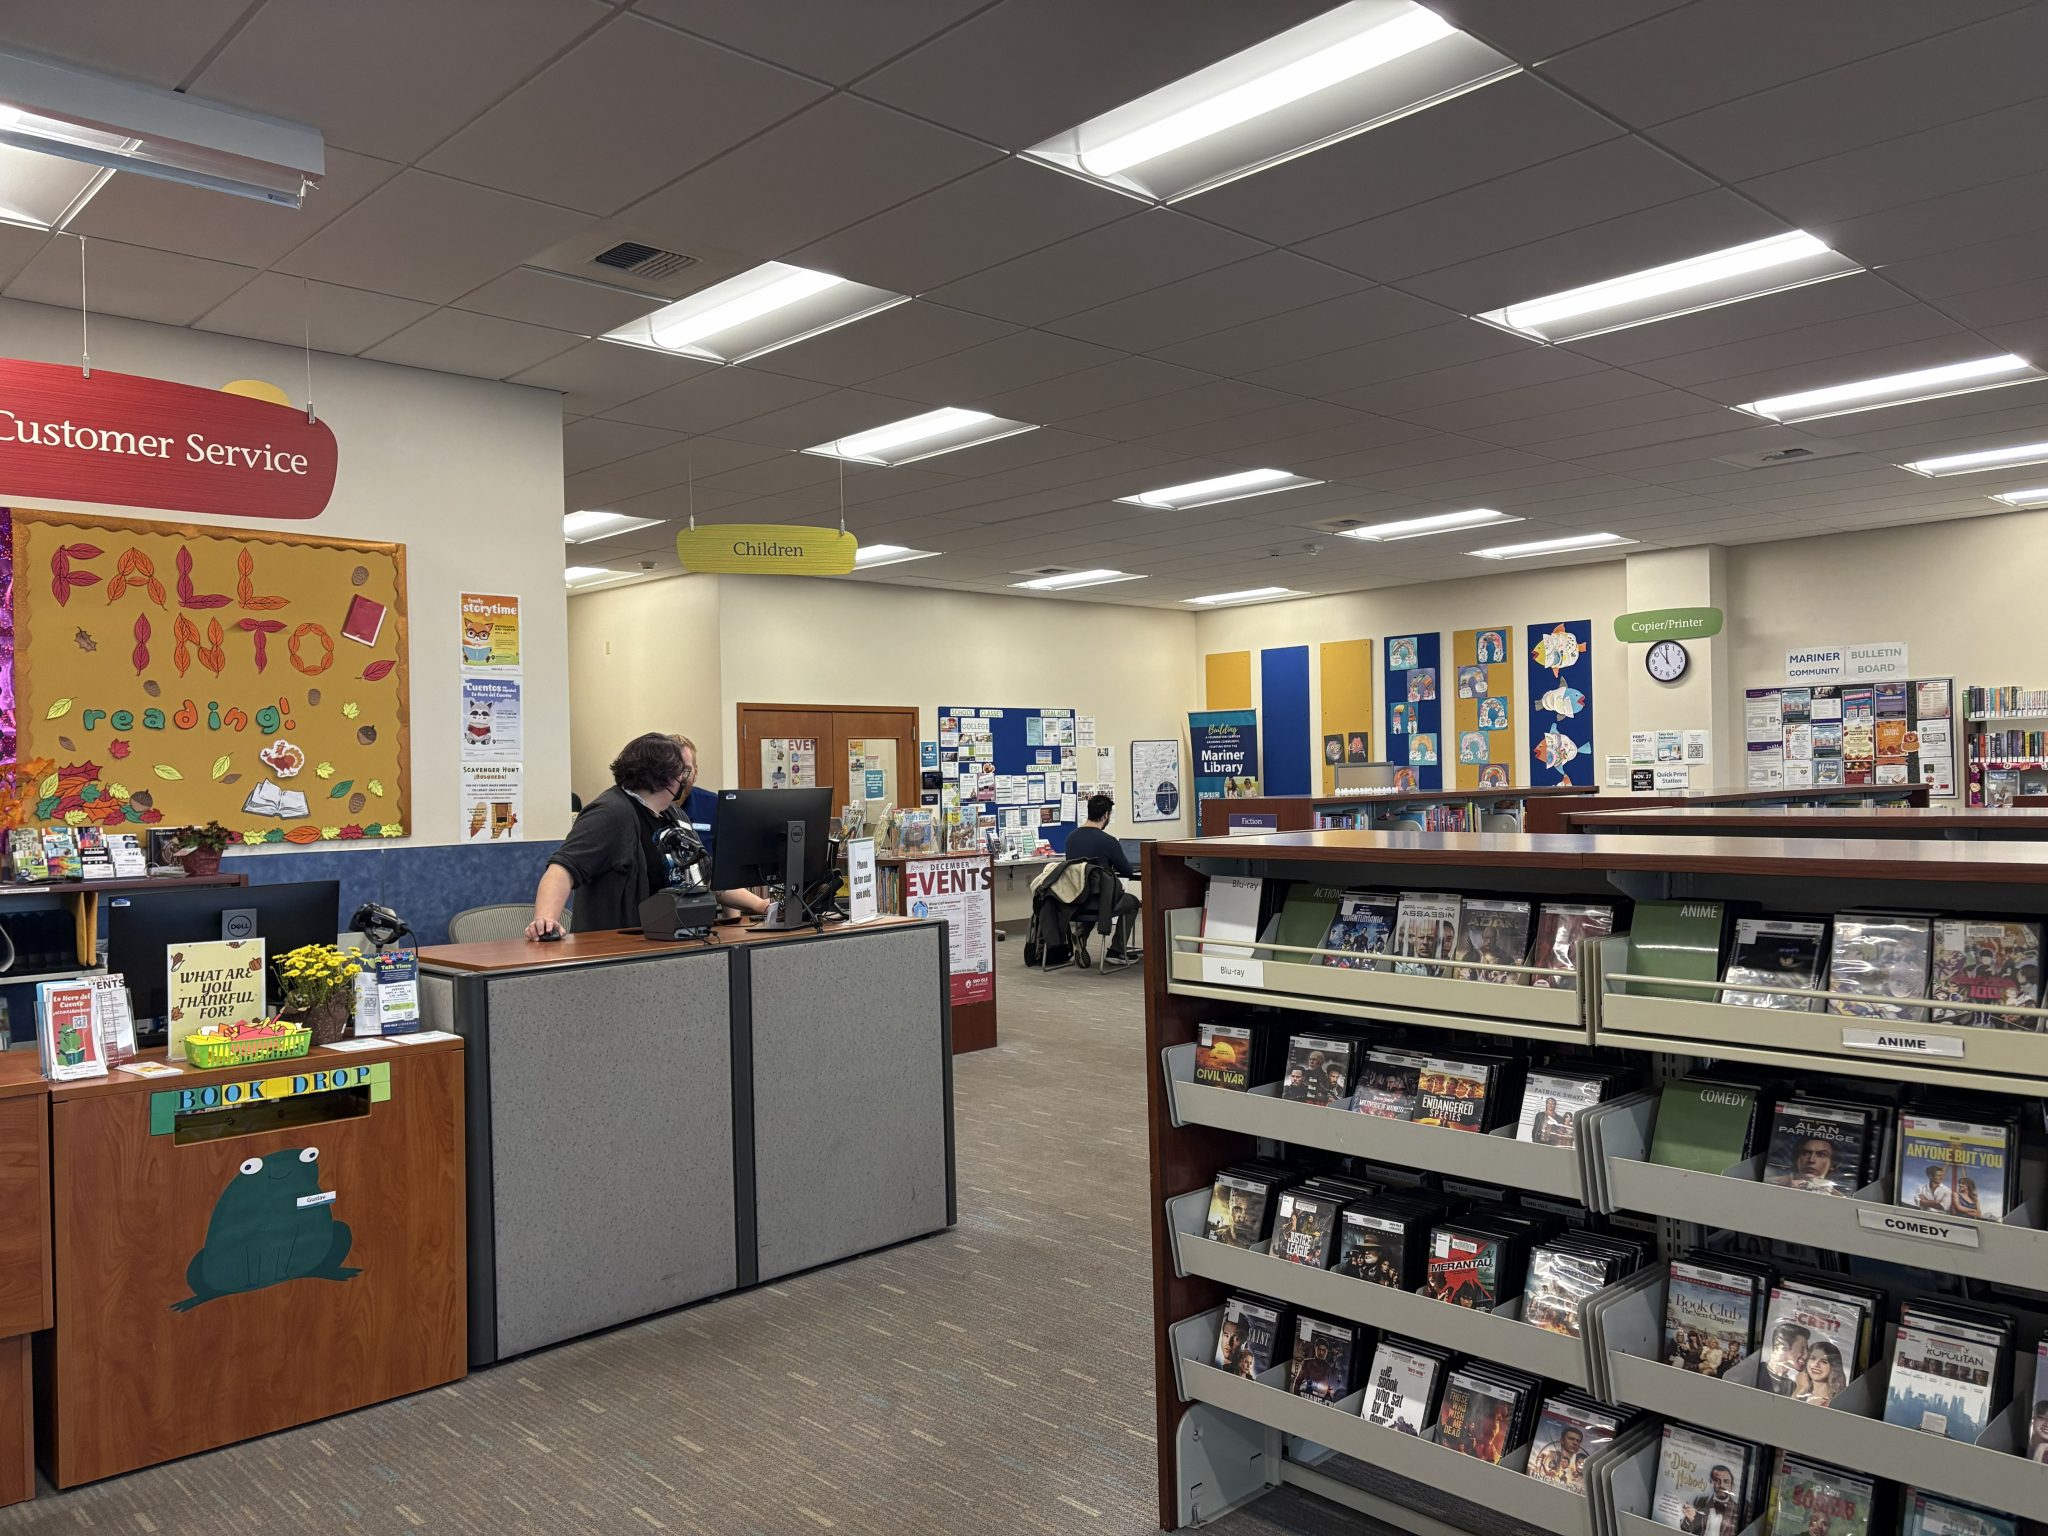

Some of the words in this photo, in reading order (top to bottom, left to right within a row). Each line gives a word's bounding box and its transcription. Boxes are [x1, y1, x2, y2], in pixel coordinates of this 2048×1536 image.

[0, 409, 174, 460] Customer
[186, 433, 308, 476] Service
[733, 541, 804, 557] Children
[51, 542, 291, 611] FALL
[463, 603, 517, 617] storytime
[1631, 617, 1704, 634] Copier/Printer
[132, 612, 335, 678] INTO
[1789, 652, 1840, 664] MARINER
[1851, 648, 1902, 660] BULLETIN
[1789, 667, 1840, 677] COMMUNITY
[1857, 663, 1895, 674] BOARD
[466, 682, 502, 692] Cuentos
[82, 696, 297, 735] reading!
[961, 722, 989, 730] COLLEGE
[1208, 723, 1239, 735] Building
[1201, 749, 1245, 761] Mariner
[1203, 761, 1244, 775] Library
[1241, 817, 1263, 825] Fiction
[930, 861, 970, 871] DECEMBER
[905, 866, 992, 897] EVENTS
[1232, 879, 1259, 891] Blu-ray
[1313, 888, 1342, 899] ACTION
[1402, 910, 1455, 919] ASSASSIN
[1680, 904, 1718, 919] ANIME
[230, 922, 249, 930] DELL
[180, 969, 224, 984] WHAT
[225, 968, 254, 980] ARE
[1220, 965, 1245, 978] Blu-ray
[201, 981, 232, 997] YOU
[178, 991, 254, 1008] THANKFUL
[199, 1005, 235, 1019] FOR?
[1877, 1036, 1927, 1050] ANIME
[1196, 1068, 1221, 1082] CIVIL
[1223, 1071, 1245, 1085] WAR
[178, 1081, 266, 1110] BOOK
[291, 1066, 370, 1095] DROP
[1535, 1087, 1561, 1097] PATRICK
[1700, 1089, 1748, 1107] COMEDY
[1422, 1096, 1474, 1116] ENDANGERED
[1428, 1108, 1462, 1122] SPECIES
[1778, 1126, 1855, 1143] PARTRIDGE
[1795, 1122, 1840, 1134] ALAN
[1906, 1143, 1953, 1162] ANYONE
[1954, 1149, 1978, 1165] BUT
[1977, 1152, 2004, 1169] YOU
[306, 1194, 326, 1203] Gustav
[1884, 1218, 1950, 1238] COMEDY
[1288, 1231, 1312, 1246] JUSTICE
[1286, 1242, 1310, 1258] LEAGUE
[1431, 1258, 1493, 1272] MERANTAU
[1676, 1293, 1708, 1312] Book
[1710, 1302, 1742, 1320] Club
[1681, 1306, 1693, 1314] The
[1694, 1310, 1708, 1319] Next
[1709, 1313, 1735, 1325] Chapter
[1247, 1328, 1271, 1346] SAINT
[1377, 1375, 1399, 1393] spook
[1375, 1387, 1391, 1404] who
[1390, 1393, 1404, 1408] sat
[1450, 1391, 1470, 1404] THOSE
[1371, 1400, 1382, 1414] by
[1382, 1403, 1395, 1419] the
[1452, 1401, 1467, 1413] WHO
[1448, 1408, 1465, 1424] WISH
[1443, 1425, 1461, 1438] DEAD
[1452, 1419, 1465, 1431] ME
[1671, 1451, 1698, 1473] Diary
[1675, 1471, 1709, 1492] Nobody
